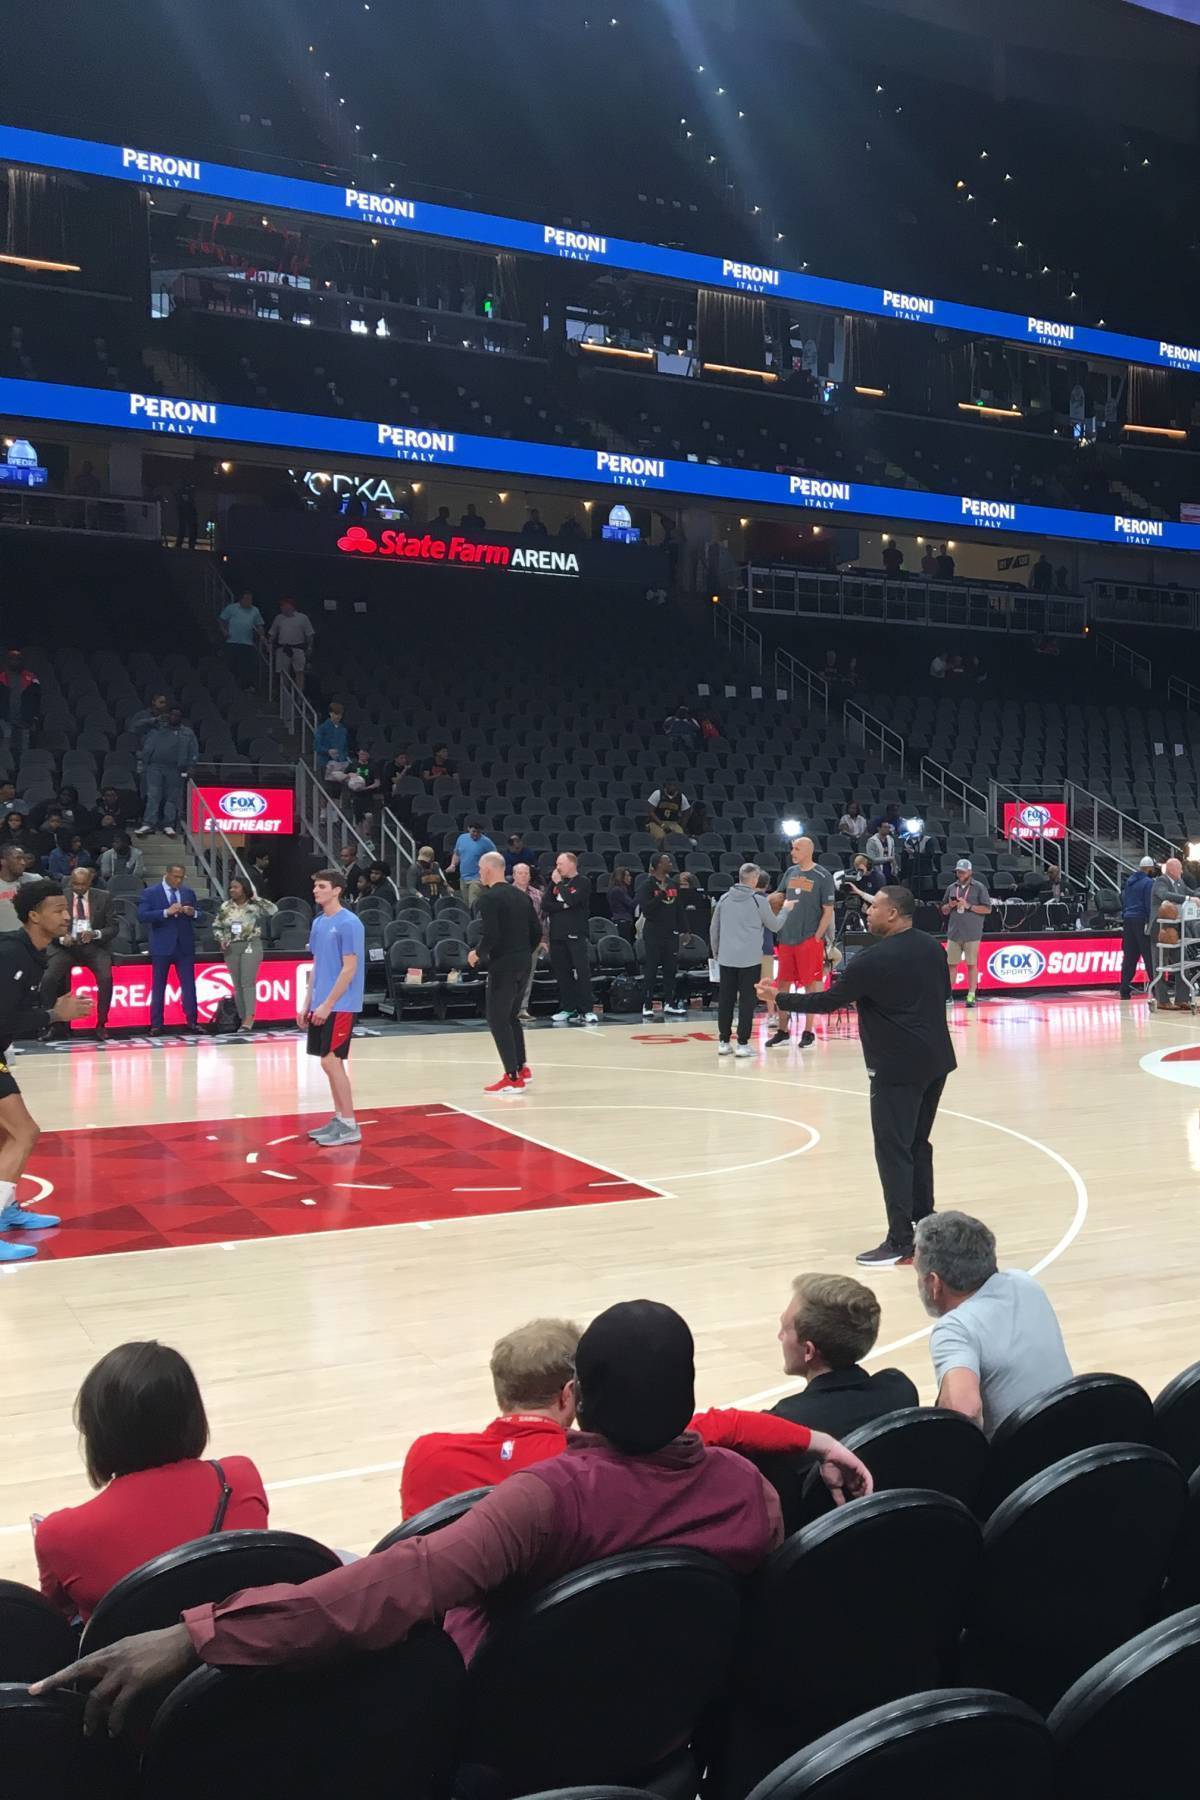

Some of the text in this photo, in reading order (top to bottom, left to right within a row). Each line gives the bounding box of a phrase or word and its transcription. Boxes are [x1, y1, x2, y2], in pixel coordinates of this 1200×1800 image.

[123, 148, 200, 180] PERONI
[142, 174, 181, 188] ITALY
[346, 188, 415, 219] PERONI
[363, 213, 397, 226] ITALY
[544, 225, 606, 254] PERONI
[559, 249, 591, 261] ITALY
[722, 259, 779, 286] PERONI
[736, 281, 764, 293] ITALY
[883, 289, 934, 315] PERONI
[895, 310, 921, 321] ITALY
[1028, 317, 1074, 341] PERONI
[1039, 337, 1062, 347] ITALY
[1170, 359, 1191, 370] ITALY
[130, 393, 216, 424] PERONI
[152, 421, 195, 434] ITALY
[378, 424, 454, 452] PERONI
[397, 449, 435, 463] ITALY
[596, 451, 664, 479] PERONI
[613, 475, 647, 488] ITALY
[789, 475, 850, 501] PERONI
[804, 498, 835, 510] ITALY
[961, 497, 1015, 520] PERONI
[975, 518, 1002, 529] ITALY
[1114, 516, 1163, 537] PERONI
[1126, 535, 1152, 545] ITALY
[379, 530, 580, 572] State Farm ARENA
[230, 797, 256, 808] FOX
[1001, 954, 1032, 968] FOX
[1000, 968, 1034, 976] SPORTS
[255, 979, 290, 1002] ON
